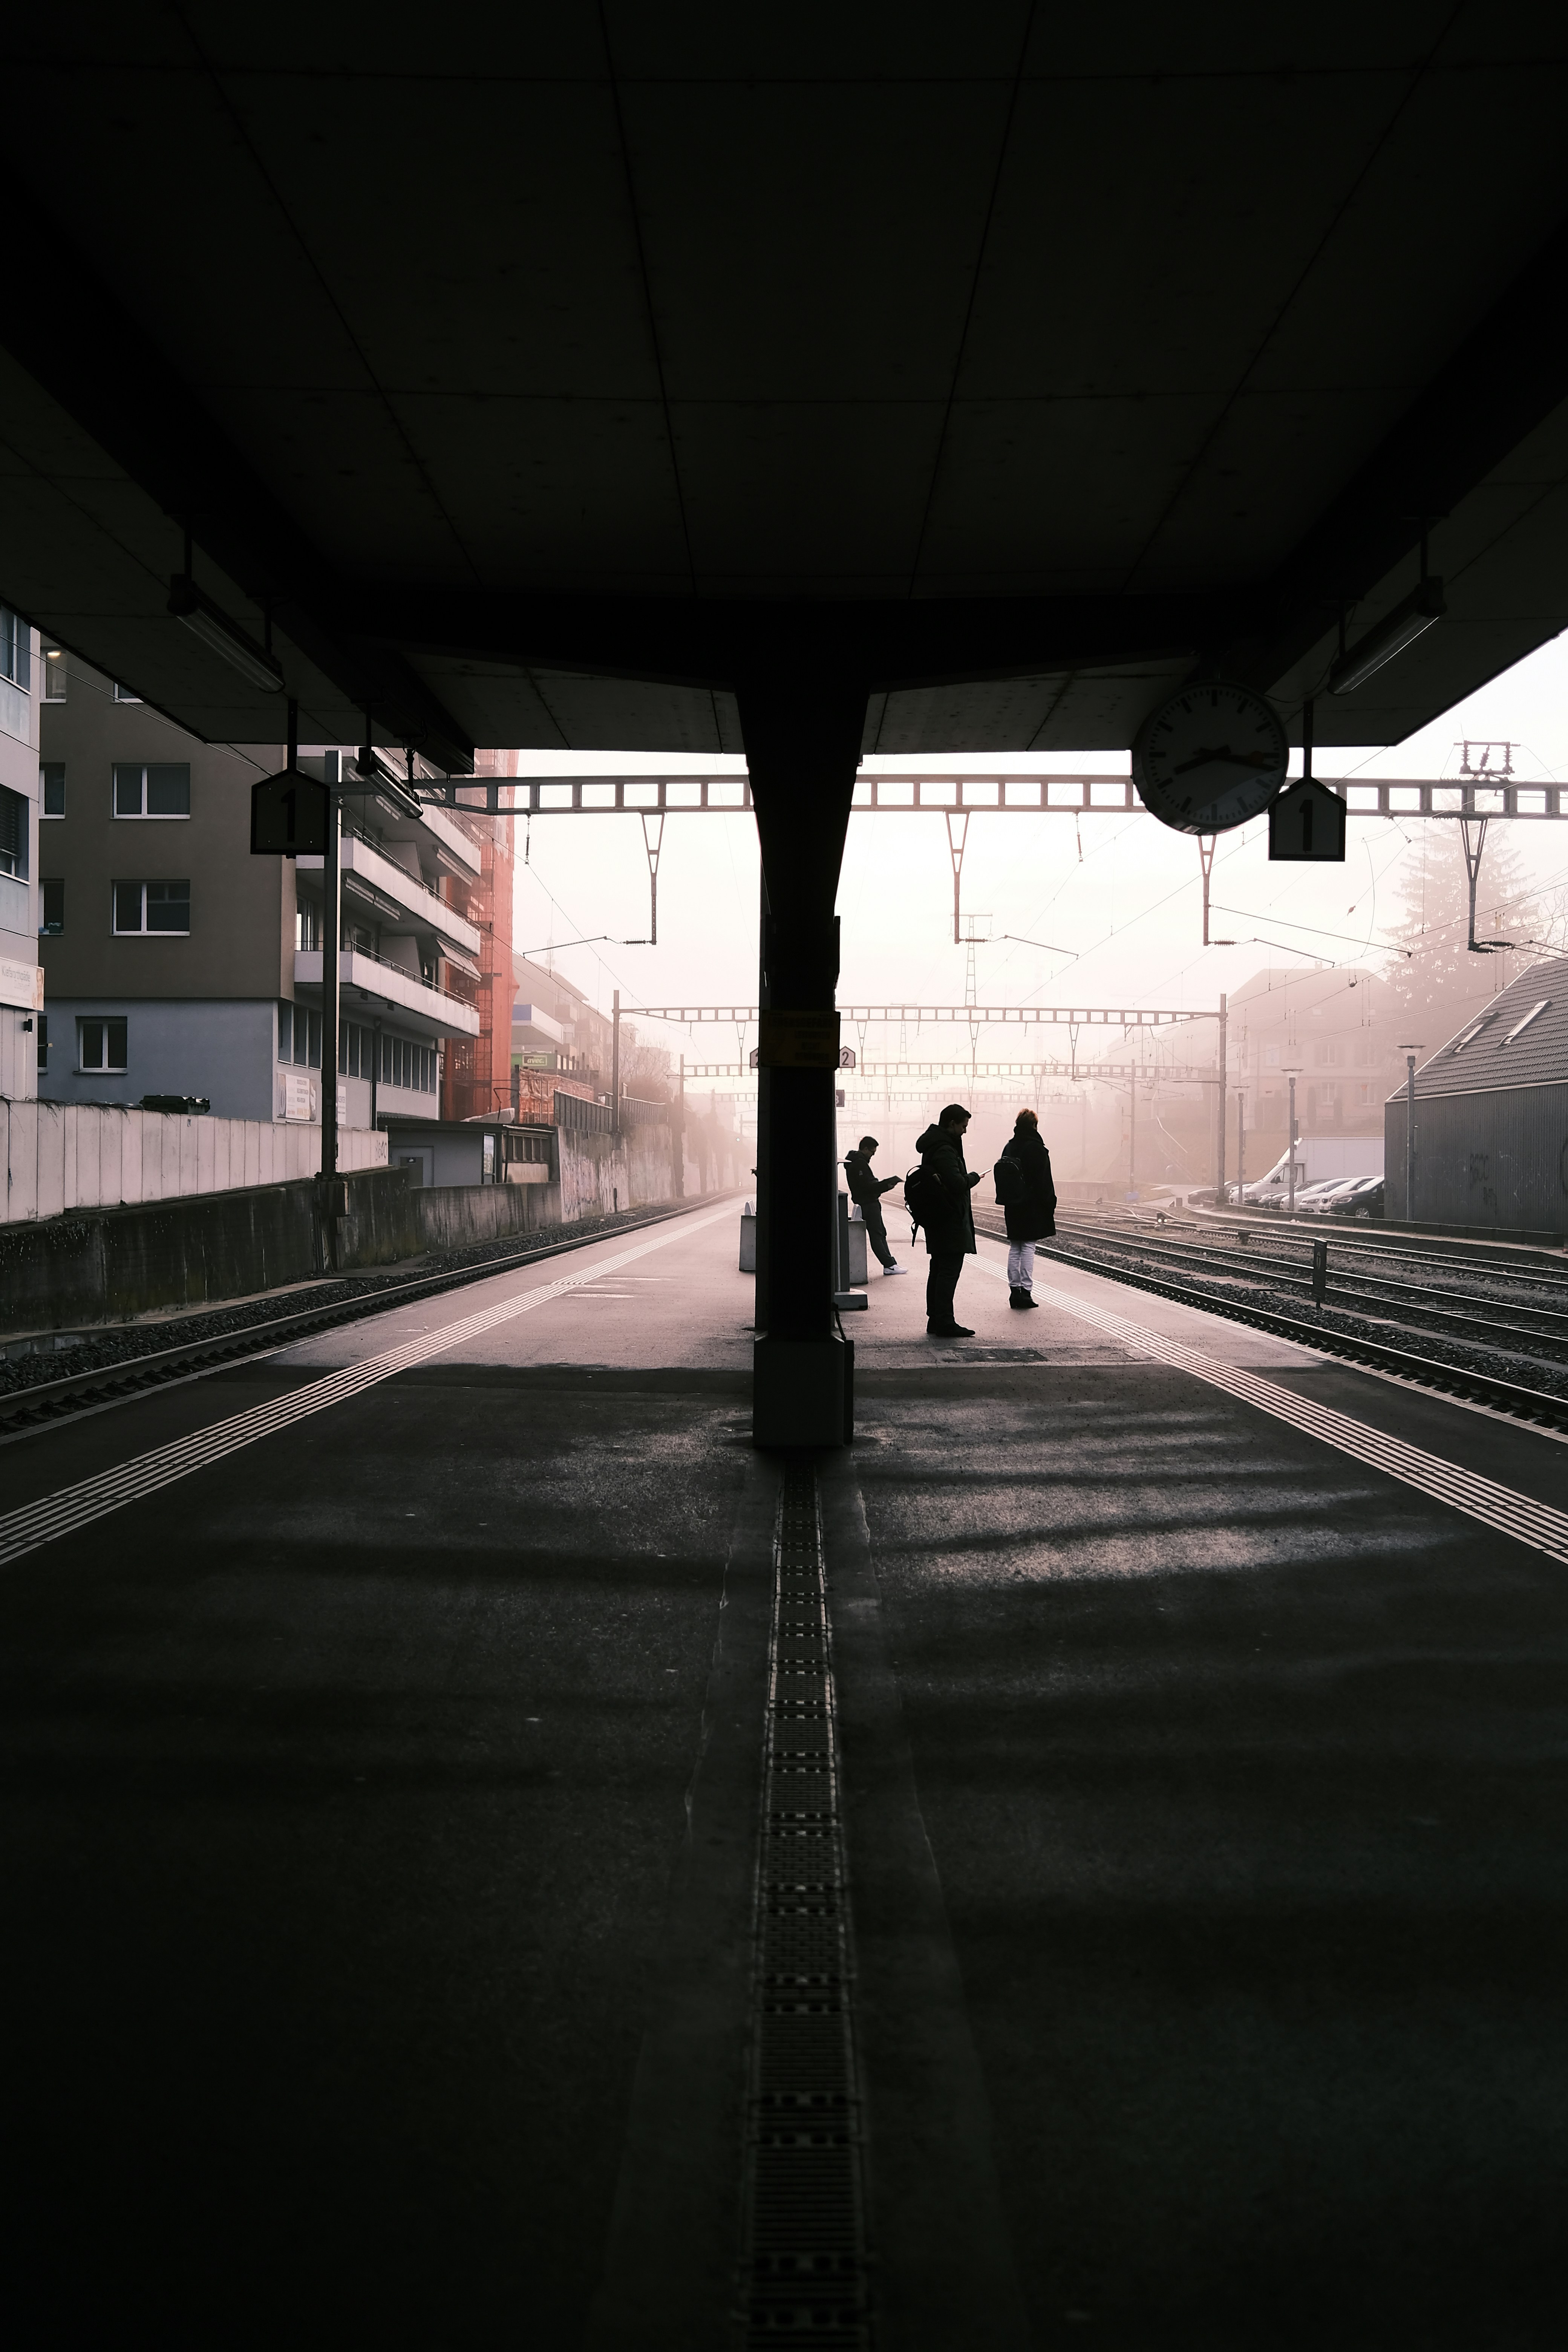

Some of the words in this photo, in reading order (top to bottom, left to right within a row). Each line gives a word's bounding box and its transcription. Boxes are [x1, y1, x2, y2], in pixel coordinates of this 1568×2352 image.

[281, 789, 296, 842] 1
[1299, 799, 1313, 851] 1
[842, 1052, 849, 1066] 2
